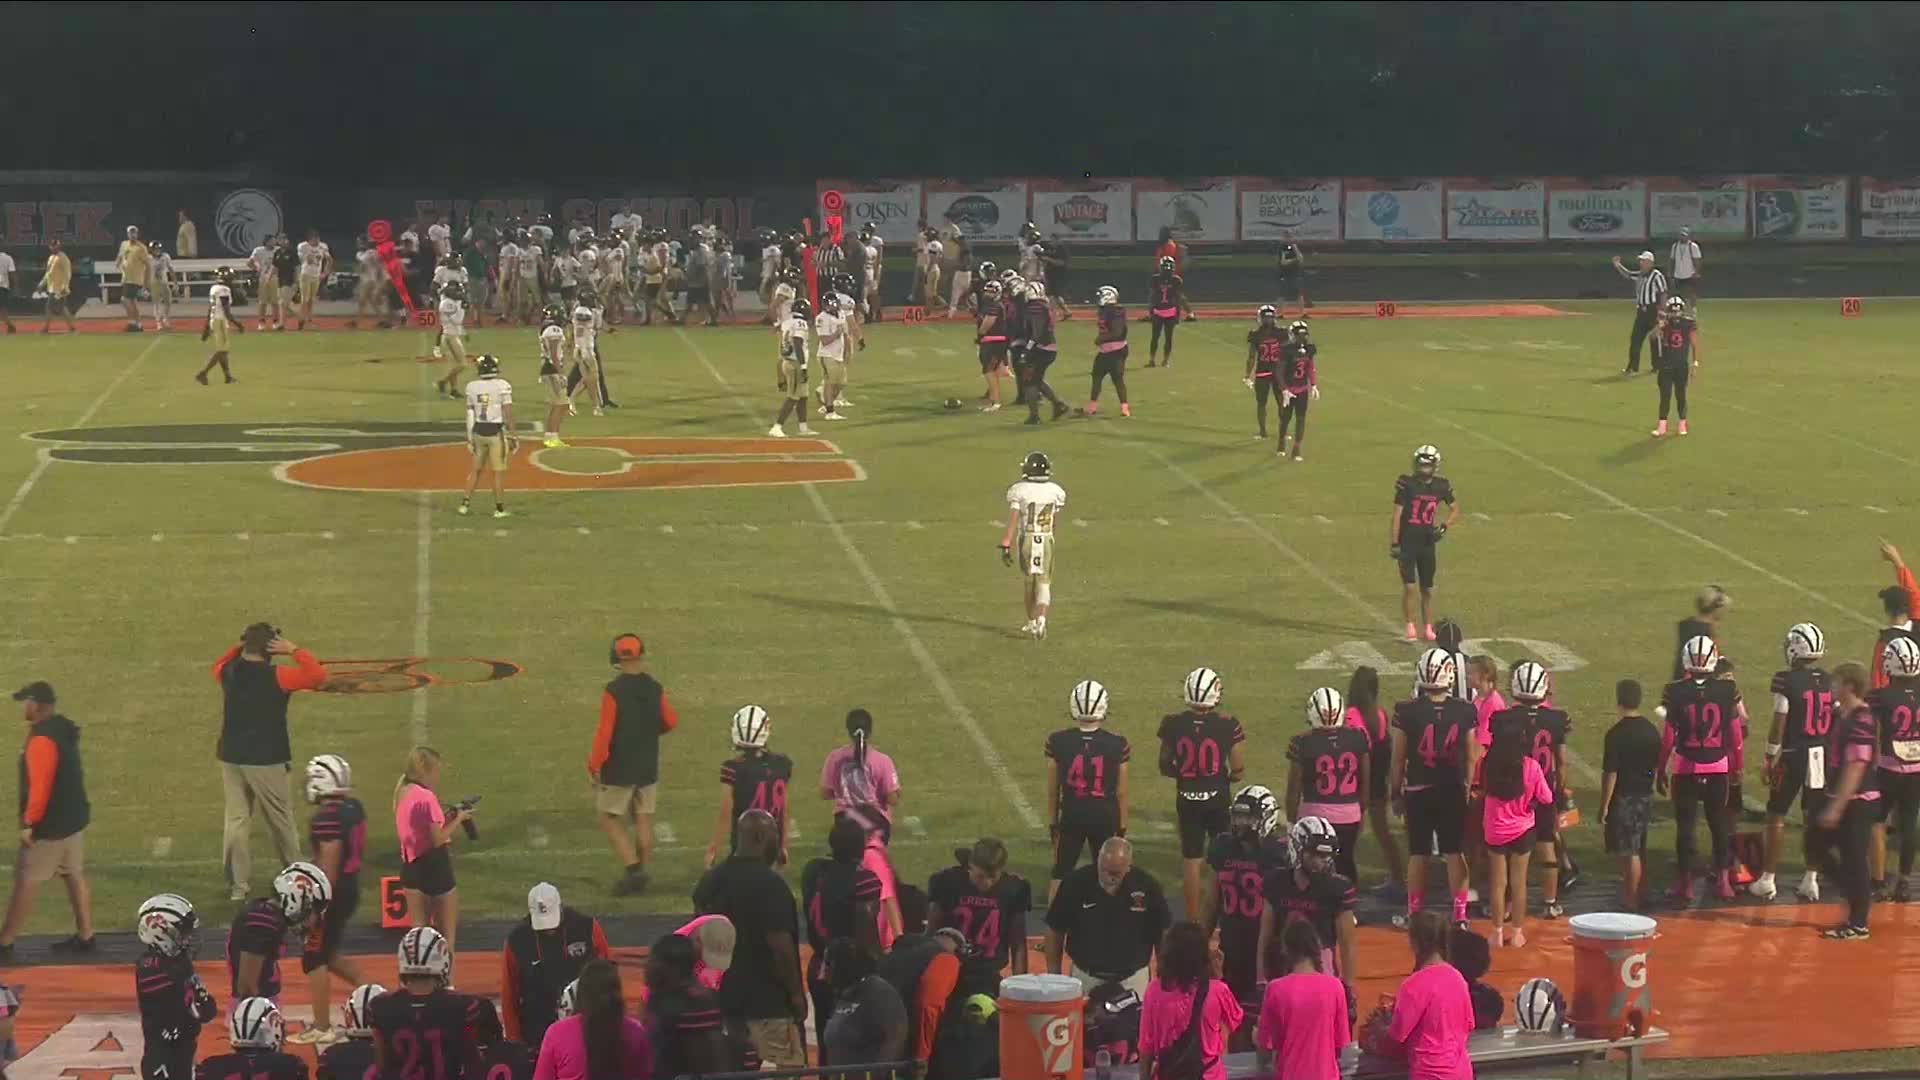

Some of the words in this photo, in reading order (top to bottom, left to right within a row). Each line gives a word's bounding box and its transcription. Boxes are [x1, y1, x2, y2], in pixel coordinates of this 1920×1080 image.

[856, 202, 908, 225] OLSEN
[1259, 193, 1320, 206] DAYTONA
[1259, 206, 1300, 217] BEACH
[419, 311, 436, 326] 50
[905, 309, 923, 322] 40
[1378, 303, 1395, 317] 30
[1845, 300, 1860, 314] 20
[1026, 501, 1053, 533] 14
[1685, 703, 1723, 748] 12
[1803, 690, 1832, 737] 15
[1175, 736, 1221, 779] 20
[1417, 723, 1460, 768] 44
[1067, 754, 1105, 799] 41
[1314, 751, 1359, 796] 32
[384, 888, 408, 919] 5
[1621, 953, 1647, 988] G
[1046, 1017, 1070, 1046] G
[392, 1027, 448, 1080] 21
